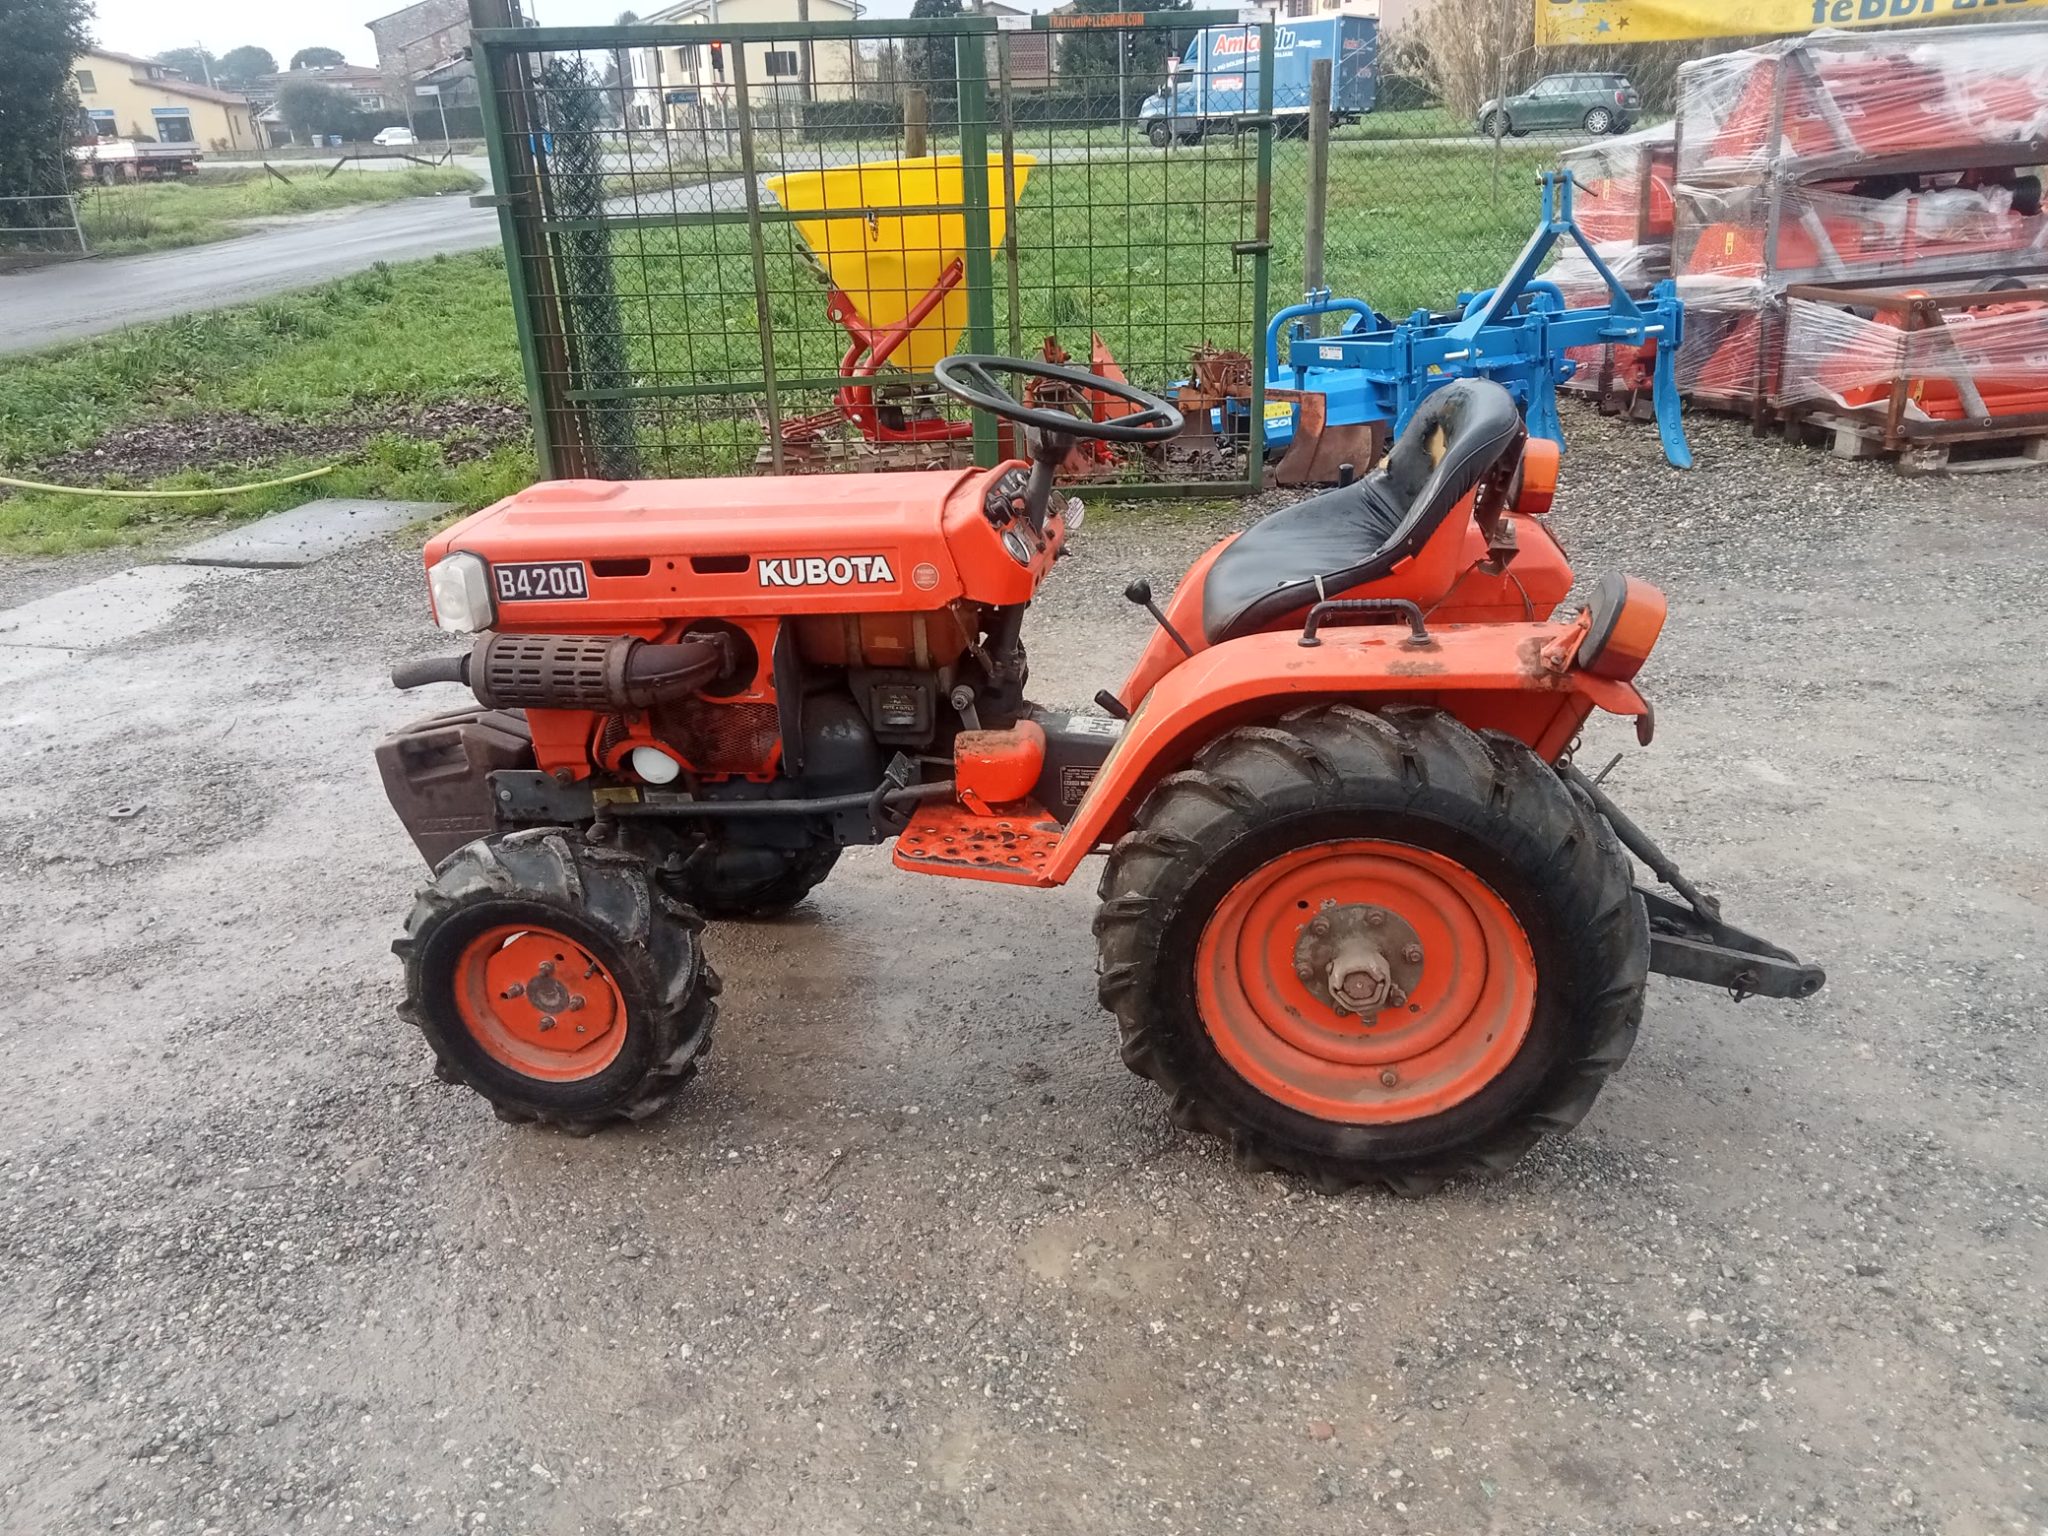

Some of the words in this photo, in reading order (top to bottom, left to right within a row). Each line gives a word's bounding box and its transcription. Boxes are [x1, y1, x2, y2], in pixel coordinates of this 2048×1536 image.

[1812, 0, 2028, 24] febbr
[497, 567, 584, 597] B4200
[758, 555, 895, 587] KUBOTA
